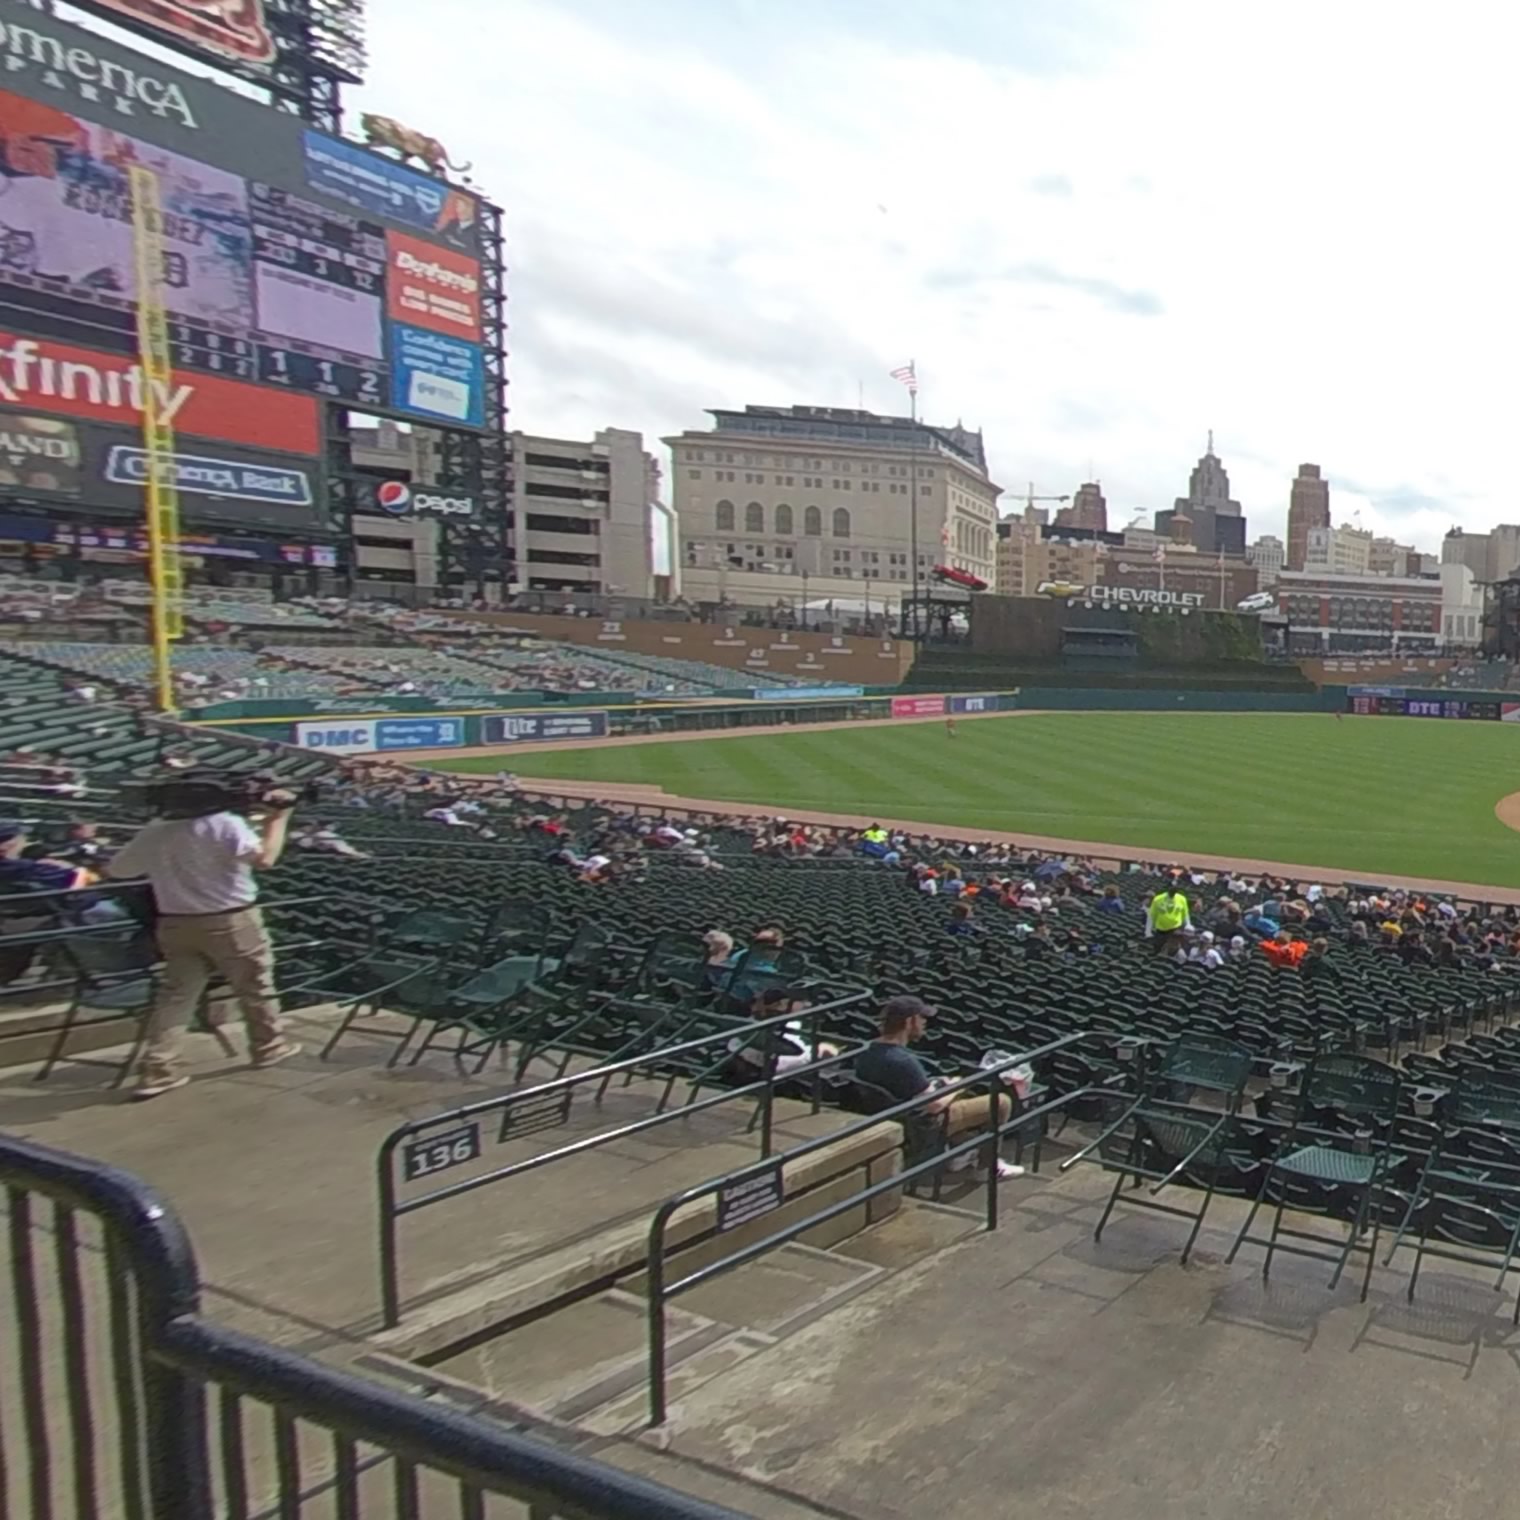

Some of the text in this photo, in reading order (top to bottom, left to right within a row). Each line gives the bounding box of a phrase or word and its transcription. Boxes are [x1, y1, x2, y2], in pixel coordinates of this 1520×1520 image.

[360, 372, 378, 392] 2
[242, 471, 297, 494] Bank
[414, 493, 473, 515] pepsi
[1091, 585, 1206, 606] CHEVROLET
[306, 728, 369, 748] DMC
[502, 717, 538, 739] Lite
[413, 1136, 473, 1177] 136
